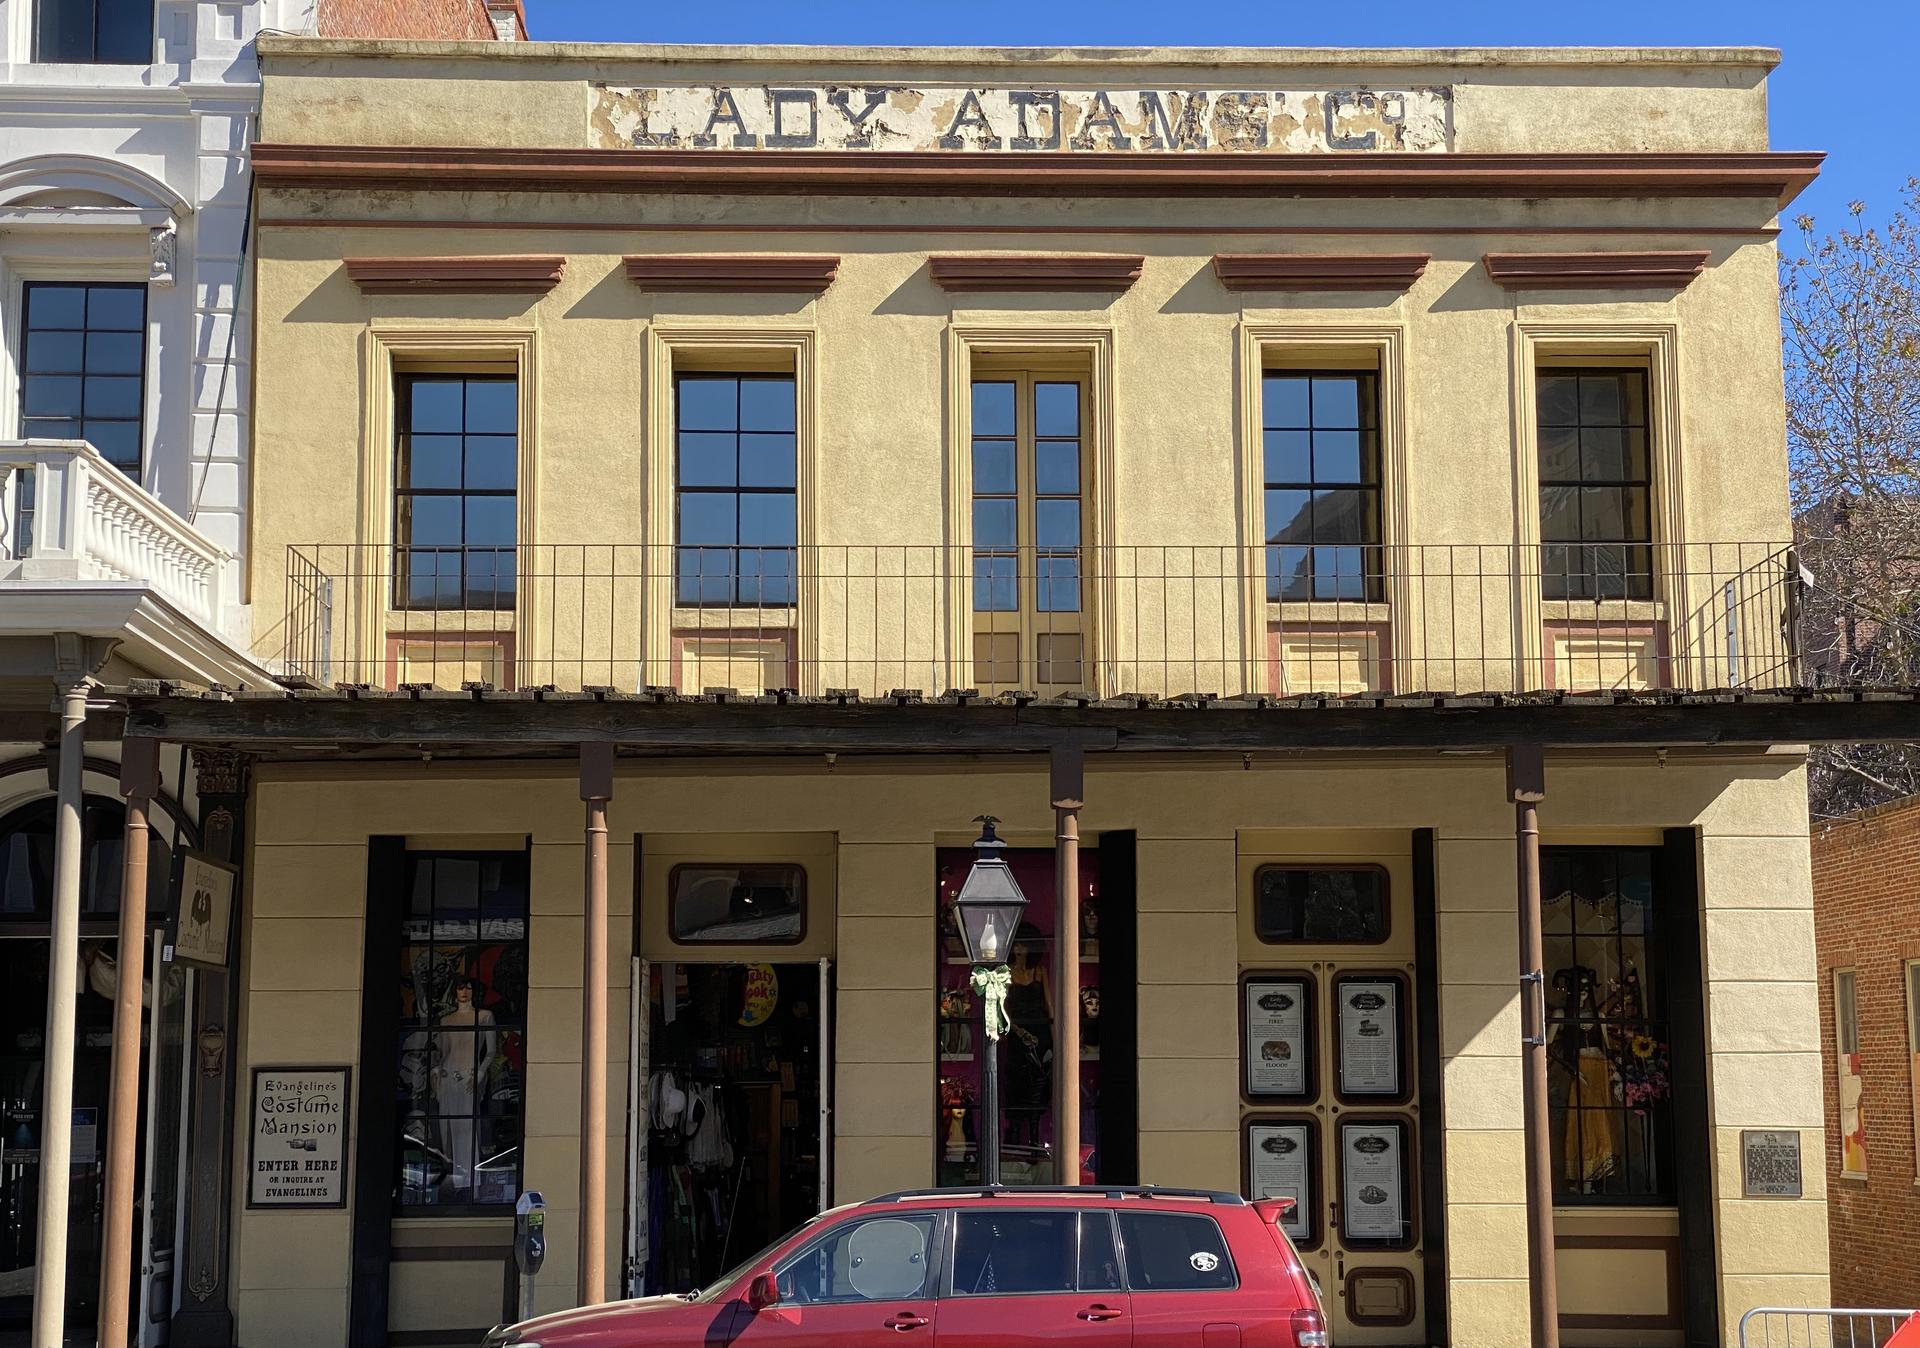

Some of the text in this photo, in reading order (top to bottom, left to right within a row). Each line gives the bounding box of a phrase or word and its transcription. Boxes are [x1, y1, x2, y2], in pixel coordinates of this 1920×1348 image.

[631, 88, 887, 148] LADY
[264, 1080, 337, 1095] Evangeline's
[261, 1095, 340, 1115] Costume
[260, 1117, 337, 1135] Mansion
[258, 1160, 338, 1172] ENTER HERE
[282, 1176, 313, 1184] INQUIRE
[315, 1176, 325, 1184] AT
[265, 1187, 328, 1197] EVANGELINE'S
